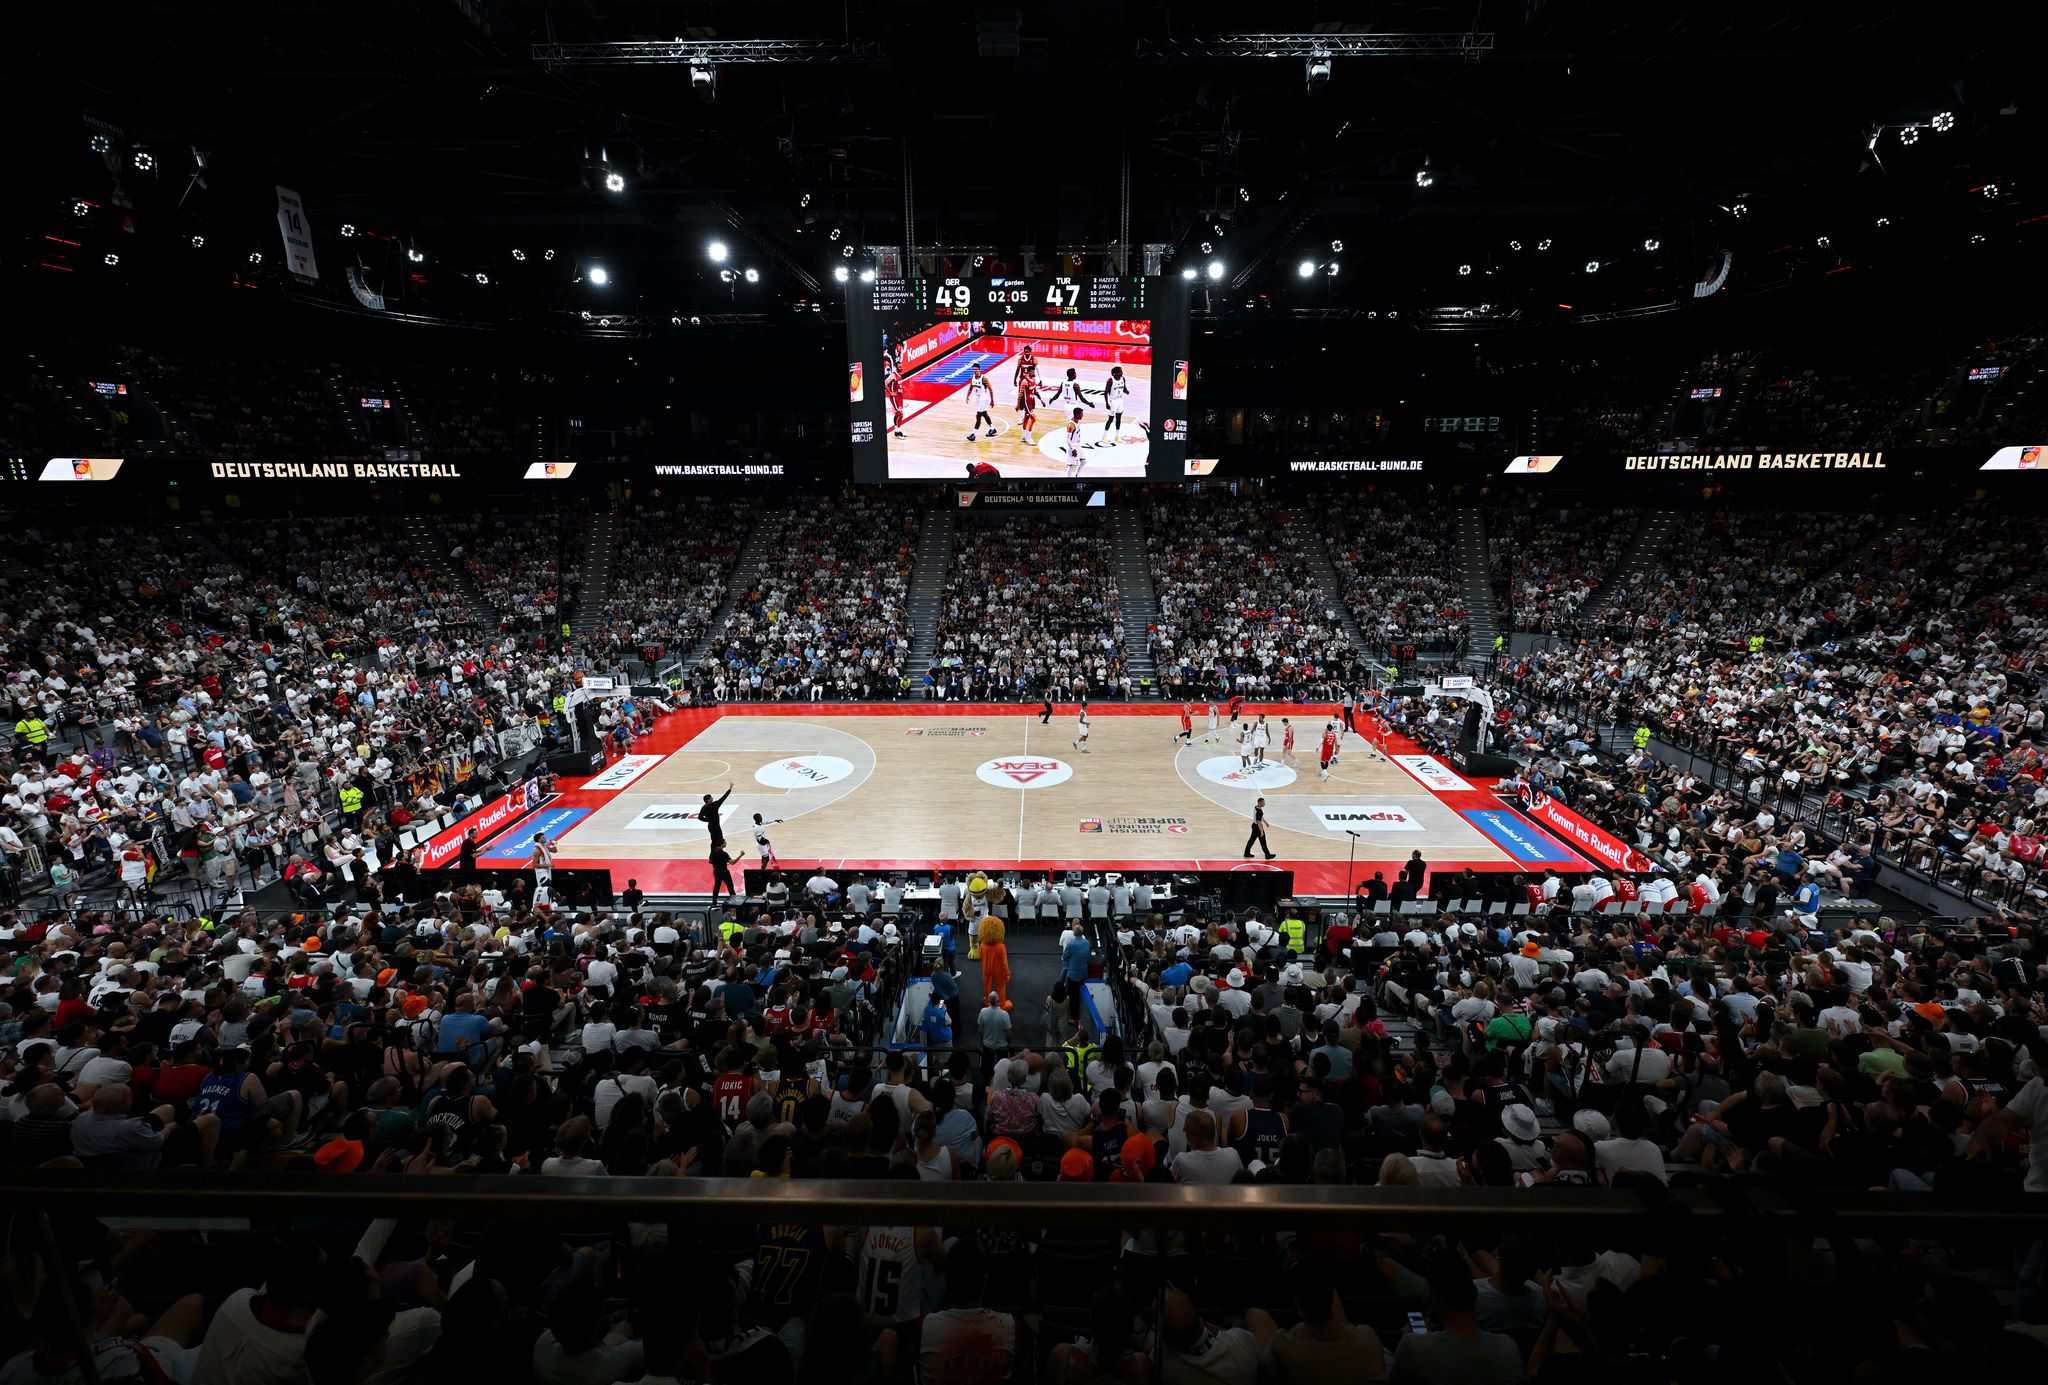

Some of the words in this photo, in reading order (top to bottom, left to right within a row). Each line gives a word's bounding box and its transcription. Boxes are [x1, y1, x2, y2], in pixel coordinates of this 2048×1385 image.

[1056, 277, 1071, 285] TUR
[935, 285, 971, 307] 49
[988, 290, 1028, 303] 02:05
[1046, 285, 1080, 307] 47
[1005, 305, 1014, 314] 3.
[1013, 320, 1047, 330] Komm
[1052, 320, 1069, 331] ins
[1073, 321, 1112, 334] Rudel!
[907, 344, 928, 362] Komm
[927, 337, 938, 351] ins
[1290, 461, 1423, 471] WWW.BASKETBALL-BUND.DE
[1625, 454, 1753, 470] DEUTSCHLAND
[1758, 452, 1887, 469] BASKETBALL
[210, 462, 349, 478] DEUTSCHLAND
[353, 463, 461, 478] BASKETBALL
[655, 465, 784, 475] WWW.BASKETBALL-BUND.DE
[1035, 495, 1079, 503] BASKETBALL
[992, 762, 1058, 770] PEAK
[1405, 757, 1440, 774] ING
[598, 768, 635, 786] ING
[798, 767, 830, 782] ING
[1324, 811, 1407, 823] tipwin
[430, 834, 463, 862] Komm
[479, 804, 507, 831] Rudel!
[1487, 817, 1524, 843] Domino's
[1519, 842, 1546, 860] Pizza
[1547, 805, 1576, 833] Komm
[1575, 823, 1589, 843] ins
[1590, 833, 1622, 864] Rudel!
[201, 1084, 231, 1096] WAGNER
[720, 1079, 743, 1091] JOKIĆ
[719, 1094, 741, 1121] 14
[757, 1244, 810, 1306] 77
[865, 1257, 902, 1314] 15
